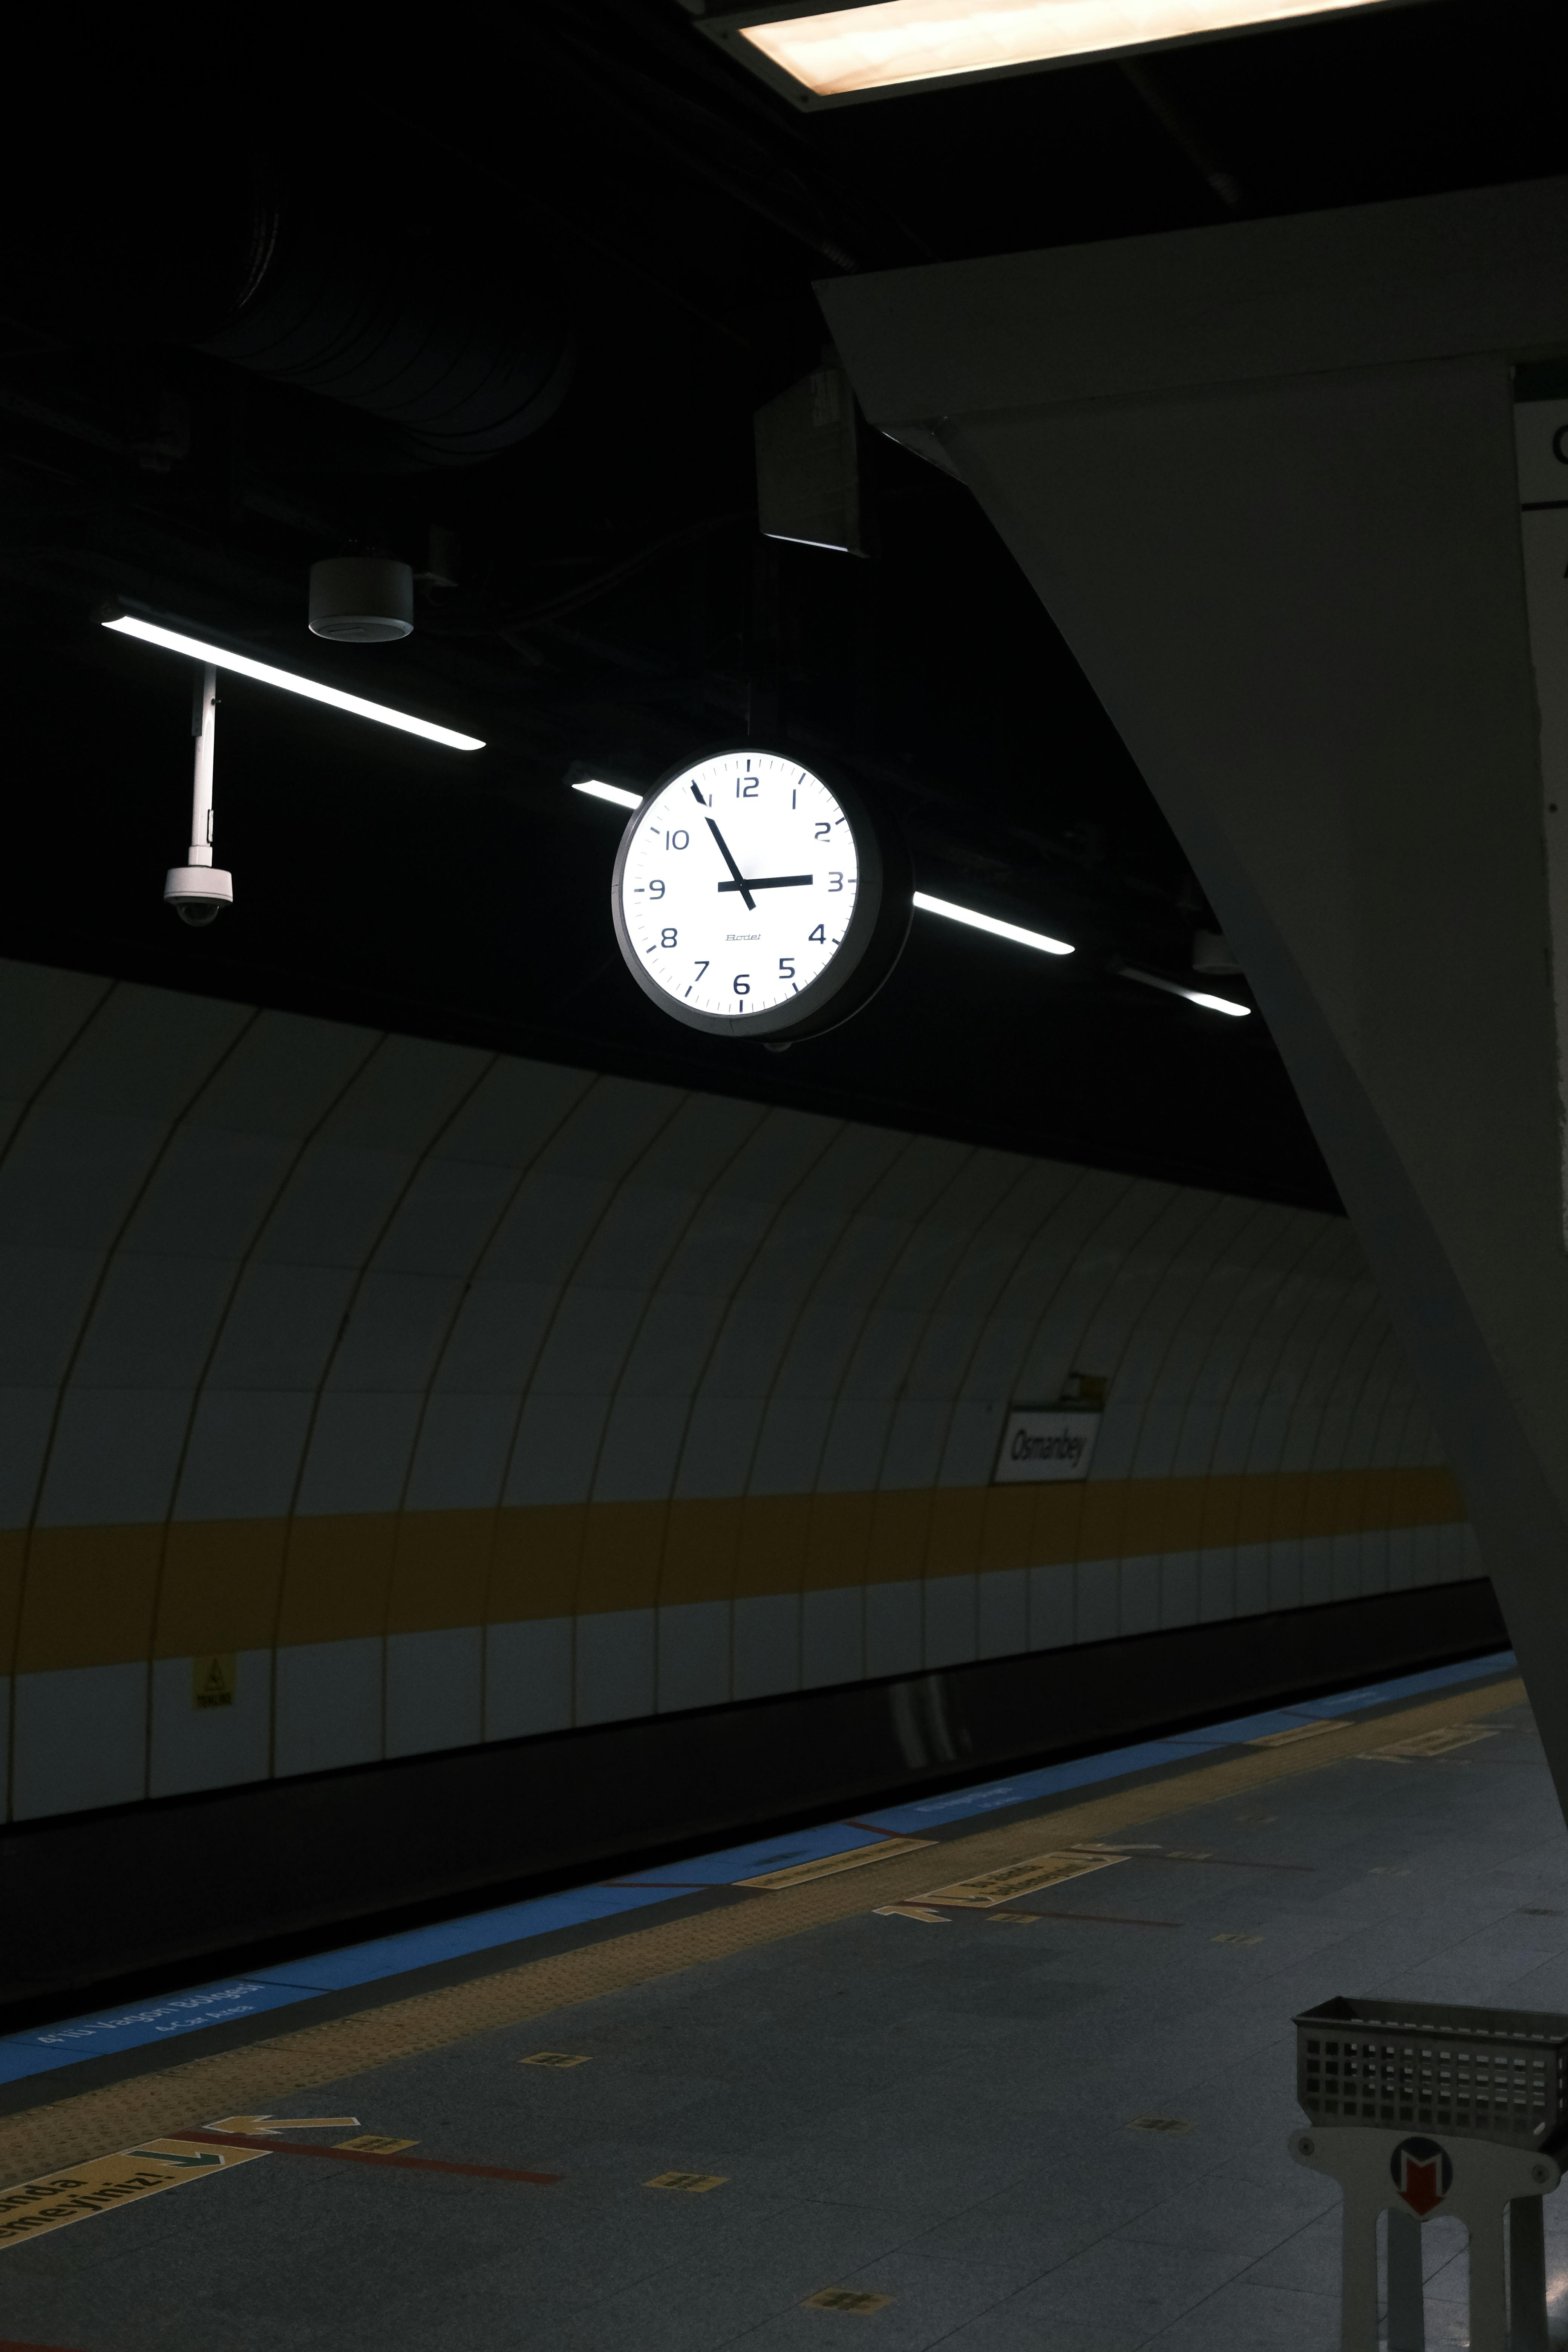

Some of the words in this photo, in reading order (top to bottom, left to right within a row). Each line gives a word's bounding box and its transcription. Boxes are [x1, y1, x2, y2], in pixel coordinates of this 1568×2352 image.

[736, 776, 760, 798] 12
[792, 789, 796, 810] 1
[666, 830, 689, 851] 10
[814, 822, 831, 843] 2
[649, 879, 666, 900] 9
[828, 871, 844, 892] 3
[661, 928, 678, 948] 8
[808, 923, 827, 945] 4
[694, 960, 710, 982] 7
[779, 957, 796, 979] 5
[733, 974, 750, 995] 6
[83, 2008, 180, 2029] Vagon
[168, 1983, 266, 2008] Bölgesi
[205, 2006, 256, 2018] Area
